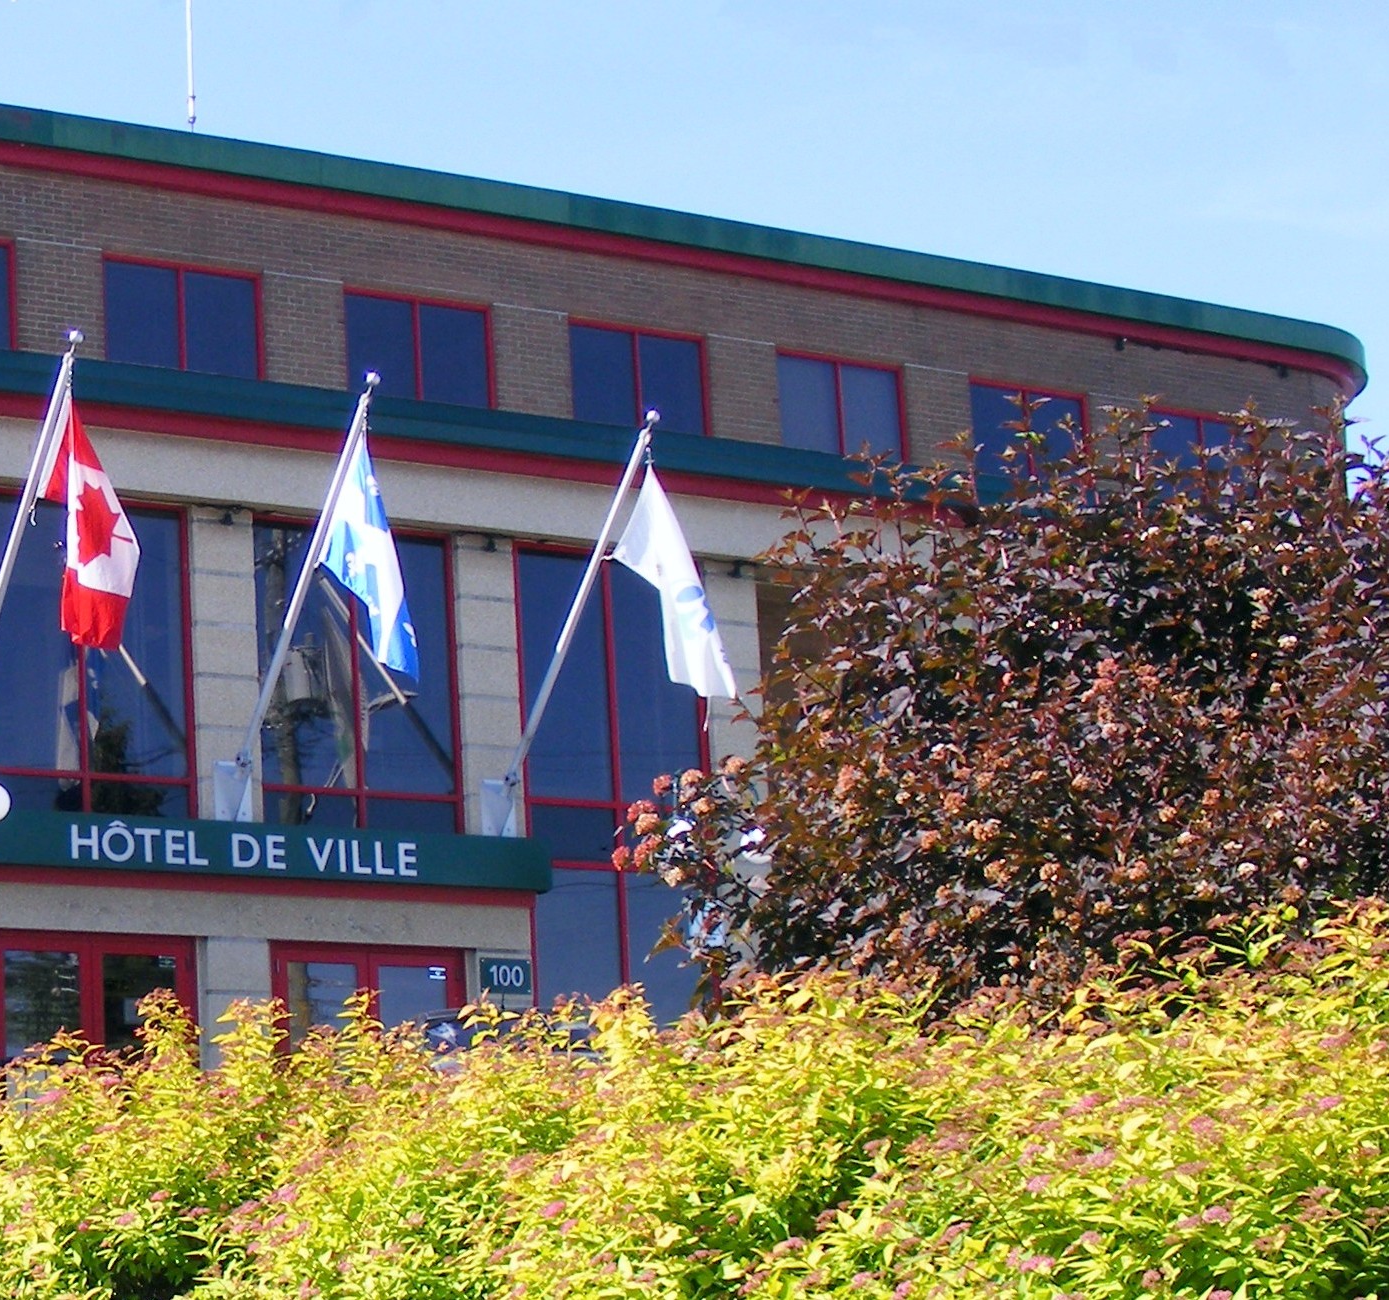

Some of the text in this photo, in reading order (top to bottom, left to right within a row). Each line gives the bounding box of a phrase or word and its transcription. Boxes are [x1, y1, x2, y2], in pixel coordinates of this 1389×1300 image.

[70, 819, 418, 877] HÔTEL DE VILLE
[489, 965, 524, 987] 100
